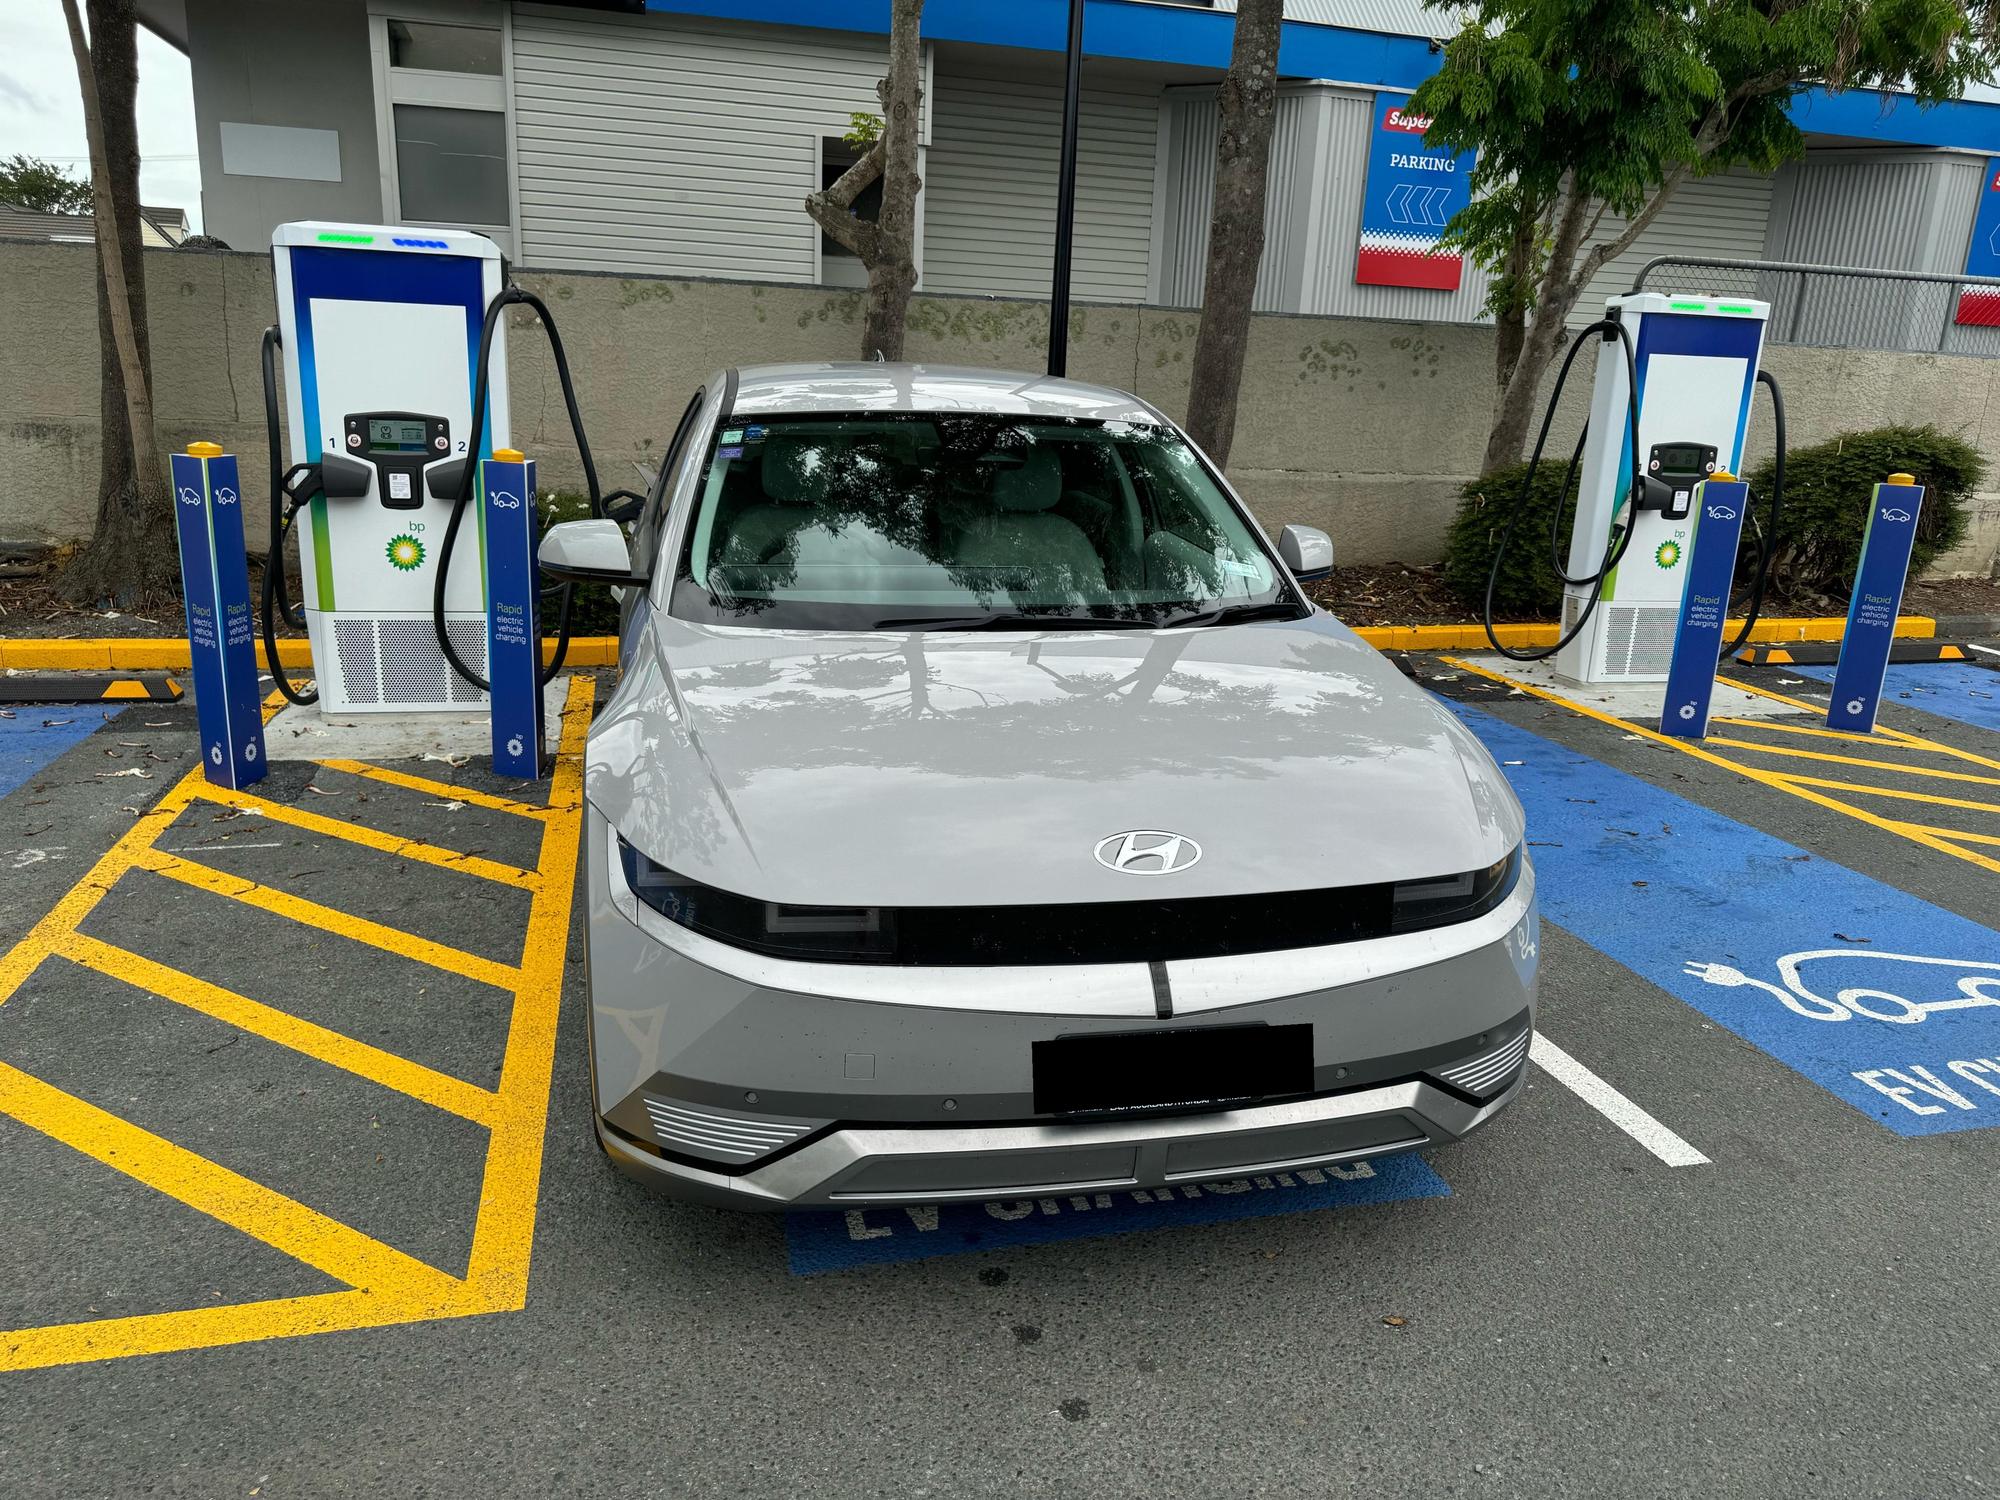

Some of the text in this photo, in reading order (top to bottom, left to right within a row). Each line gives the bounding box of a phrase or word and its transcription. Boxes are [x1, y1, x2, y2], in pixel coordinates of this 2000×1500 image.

[1389, 111, 1434, 130] Super
[1390, 153, 1455, 172] PARKING
[328, 437, 336, 449] 1
[458, 441, 467, 452] 2
[409, 520, 426, 533] bp
[1674, 529, 1686, 539] bp
[1693, 594, 1721, 605] Rapid
[1864, 593, 1892, 604] Rapid
[192, 603, 210, 616] Rapid
[227, 602, 246, 615] Rapid
[496, 602, 523, 615] Rapid
[1691, 605, 1719, 614] electric
[1861, 604, 1891, 613] electric
[1690, 611, 1717, 620] vehicle
[1861, 610, 1888, 619] vehicle
[496, 615, 524, 626] electric
[1686, 619, 1719, 629] charging
[1856, 617, 1889, 627] charging
[497, 624, 523, 634] vehicle
[495, 632, 527, 645] charging
[1850, 1064, 1978, 1116] EV
